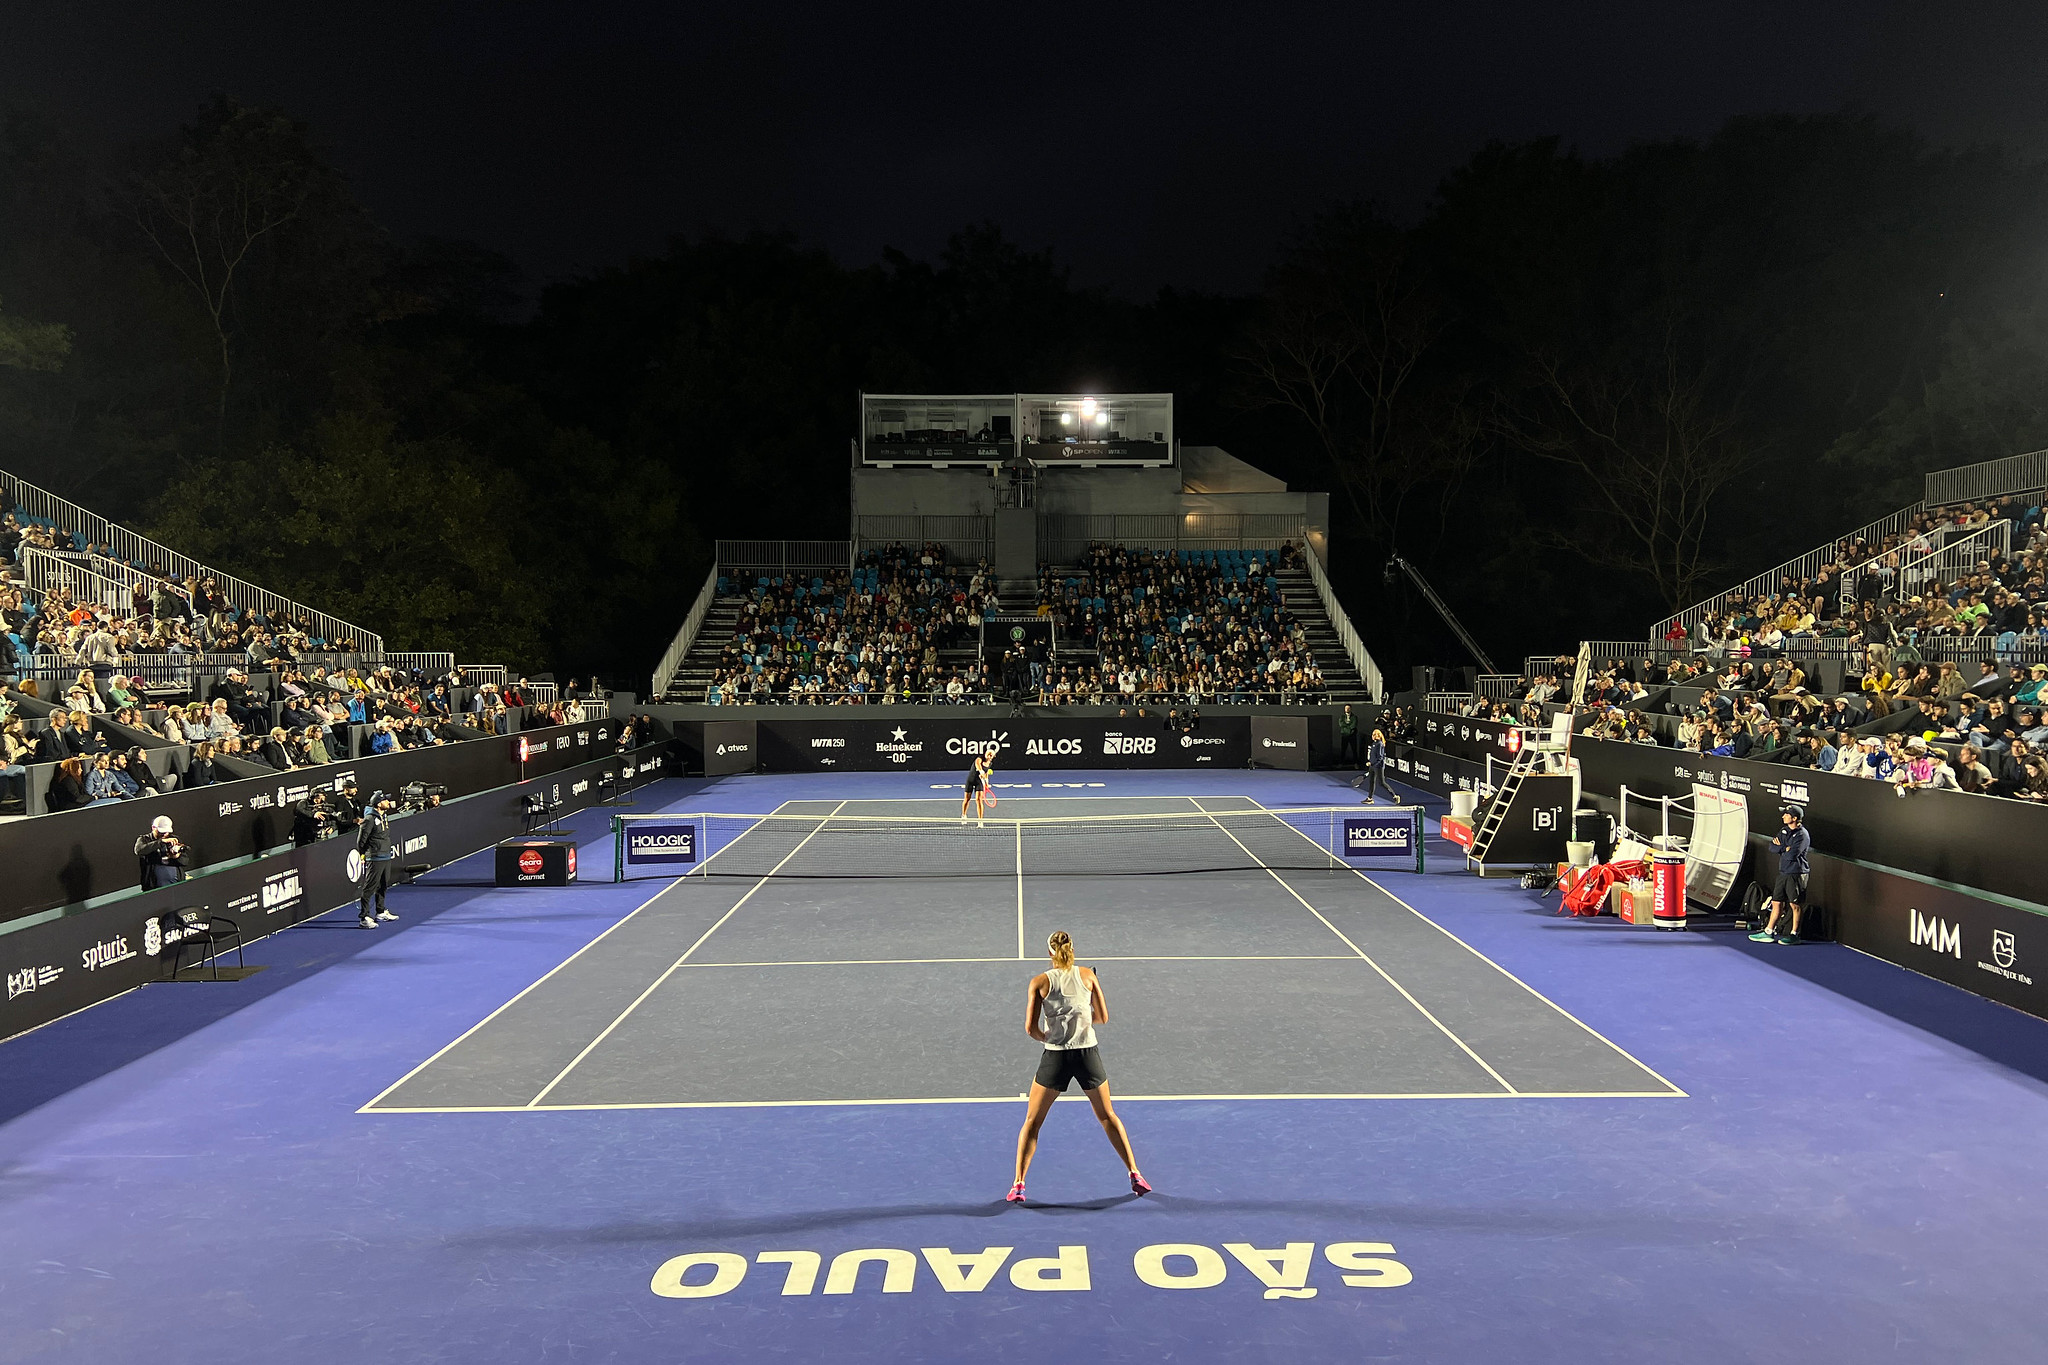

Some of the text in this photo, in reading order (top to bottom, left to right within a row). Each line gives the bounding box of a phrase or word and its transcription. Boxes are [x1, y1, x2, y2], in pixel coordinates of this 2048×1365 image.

[727, 744, 748, 752] atvos
[875, 742, 922, 752] Heineken
[945, 737, 1000, 755] Claro
[1025, 738, 1083, 755] ALLOS
[1122, 737, 1157, 754] BRB
[1737, 783, 1751, 792] PAULO
[1781, 783, 1810, 802] BRASIL
[632, 834, 690, 847] HOLOGIC
[1349, 827, 1407, 840] HOLOGIC
[519, 859, 542, 867] Seara
[518, 873, 546, 881] Gourmet
[262, 875, 302, 908] BRASIL
[1654, 869, 1665, 911] Wilson
[1910, 908, 1961, 959] IMM
[82, 934, 128, 971] spturis
[650, 1242, 1414, 1300] SÃO PAULO
